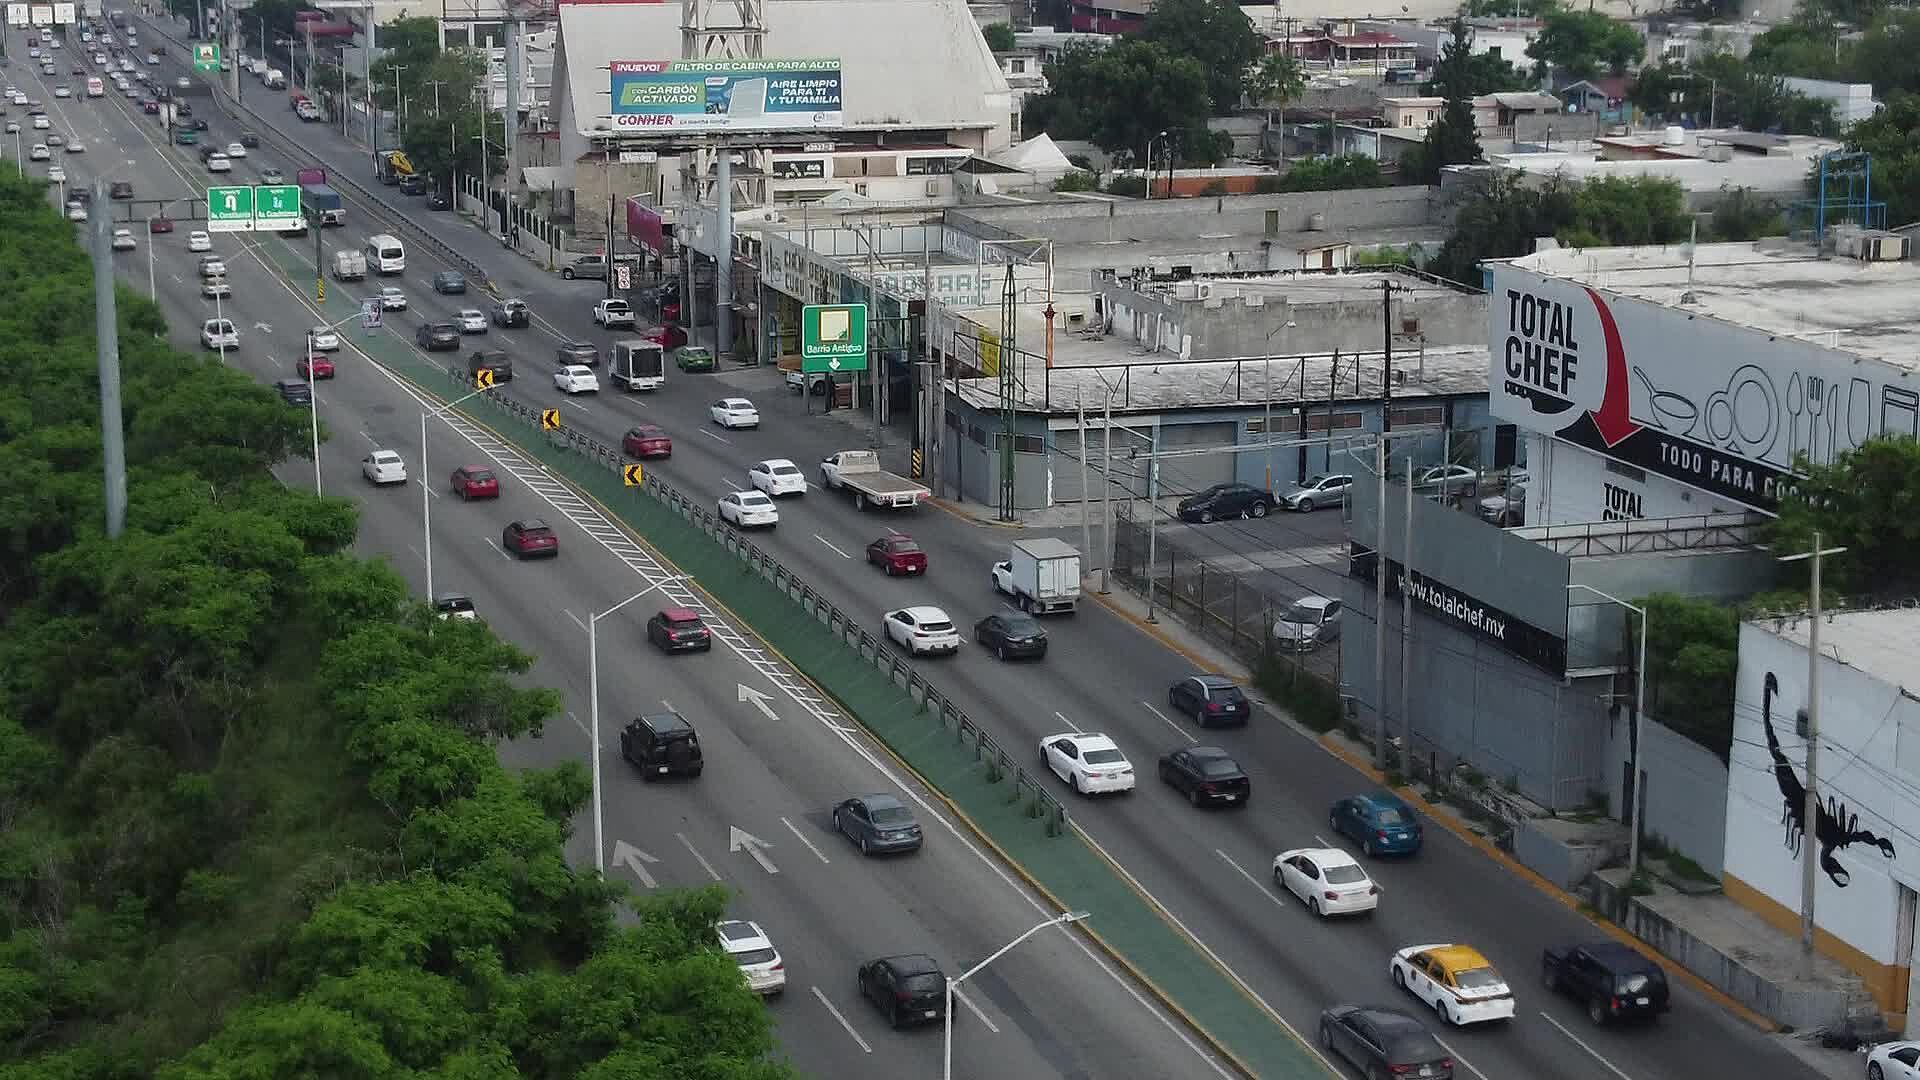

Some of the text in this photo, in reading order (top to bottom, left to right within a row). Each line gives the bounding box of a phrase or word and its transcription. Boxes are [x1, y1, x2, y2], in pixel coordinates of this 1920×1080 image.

[674, 60, 840, 71] FILTRO DE CABINA PARA AUTO
[799, 79, 838, 88] LIMPIO
[648, 84, 698, 94] CARBÓN
[782, 87, 826, 96] PARA TI
[633, 94, 697, 103] ACTIVADO
[768, 95, 840, 105] Y TU FAMILIA
[617, 114, 675, 126] GONHER
[1507, 289, 1578, 351] TOTAL
[807, 343, 862, 353] Barrio Antiguo
[1505, 335, 1578, 396] CHEF
[1660, 442, 1702, 473] TODO
[1711, 459, 1755, 493] PARA
[1603, 482, 1645, 519] TOTAL
